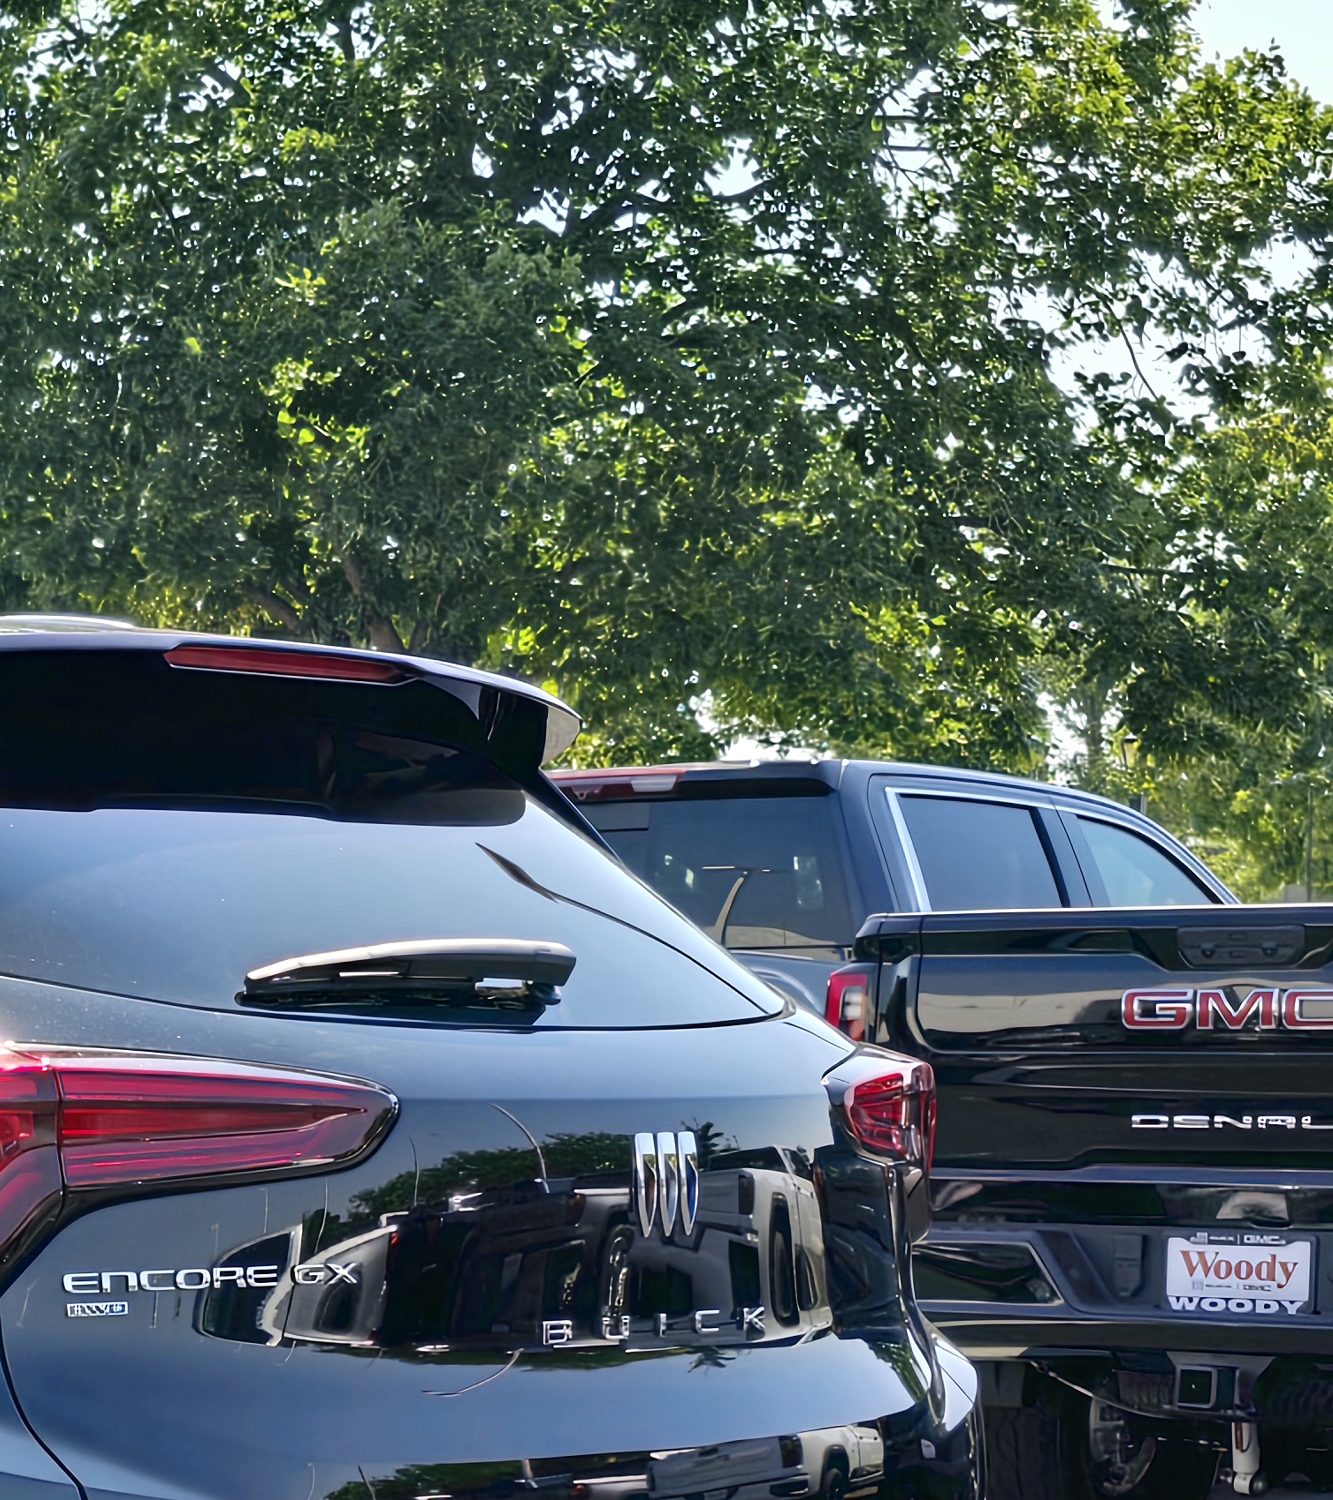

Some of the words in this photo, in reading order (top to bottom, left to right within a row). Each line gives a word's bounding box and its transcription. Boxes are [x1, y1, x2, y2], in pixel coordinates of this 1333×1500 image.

[1121, 988, 1333, 1030] GMC
[63, 1265, 278, 1294] ENCORE
[294, 1263, 358, 1285] GX
[1180, 1250, 1299, 1289] Woody
[1168, 1296, 1304, 1315] WOODY
[542, 1307, 766, 1346] BUICK
